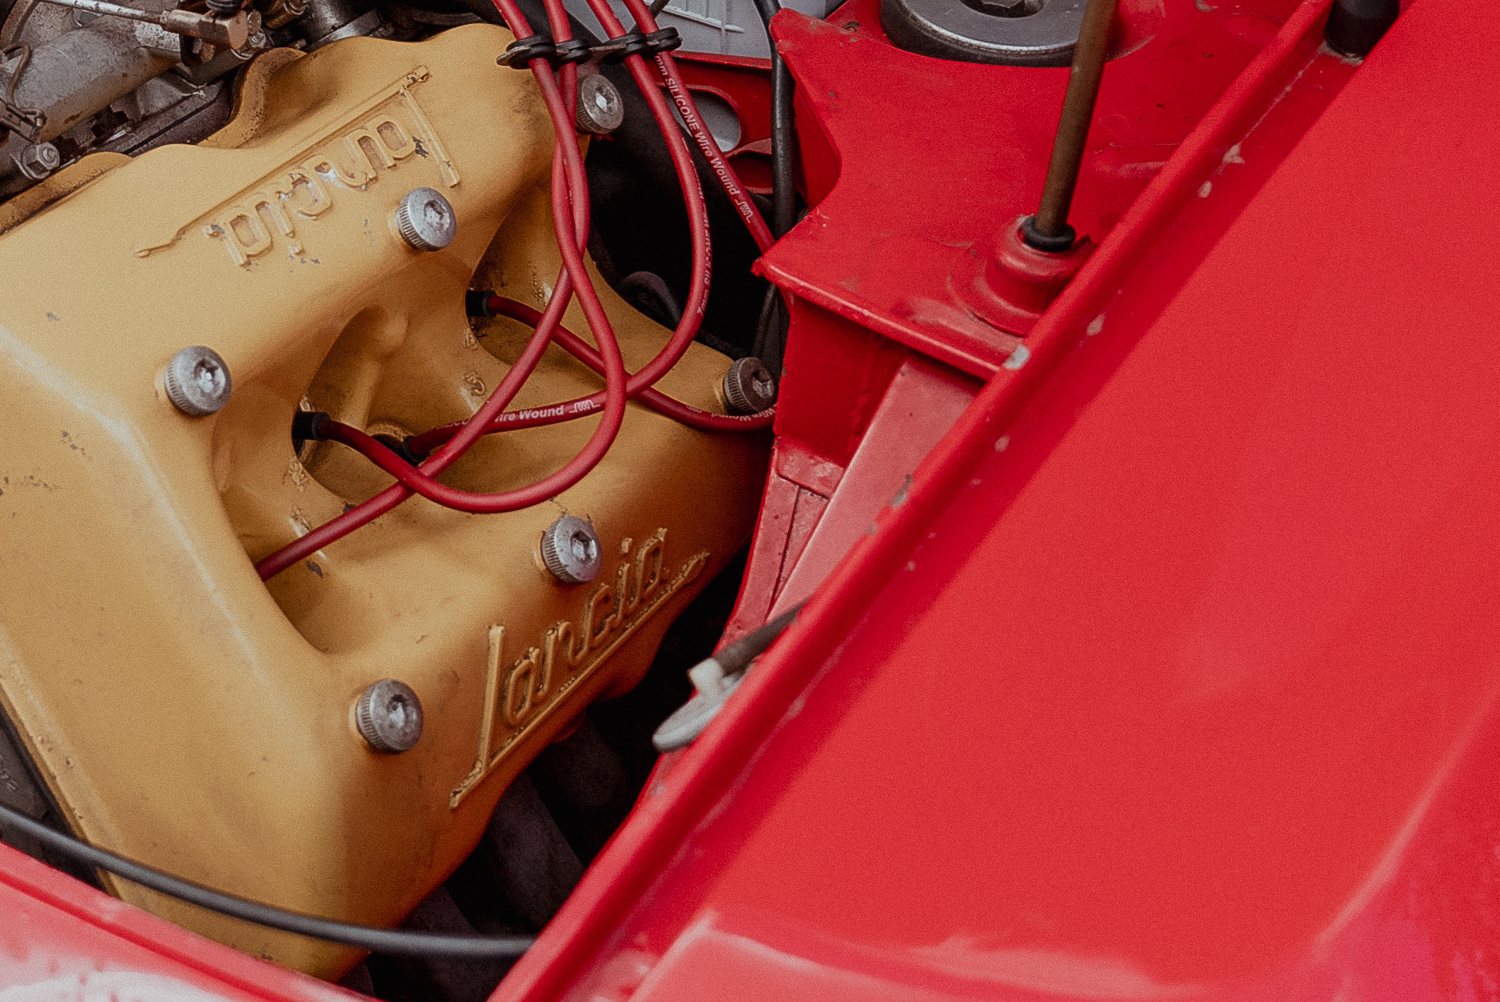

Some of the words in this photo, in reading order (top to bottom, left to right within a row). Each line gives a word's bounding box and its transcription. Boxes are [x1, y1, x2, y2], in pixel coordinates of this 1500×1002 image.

[665, 77, 700, 131] SILICONE
[696, 130, 714, 157] Wire
[710, 156, 741, 196] Wound
[518, 405, 565, 420] Wound
[450, 526, 685, 808] Lancia
